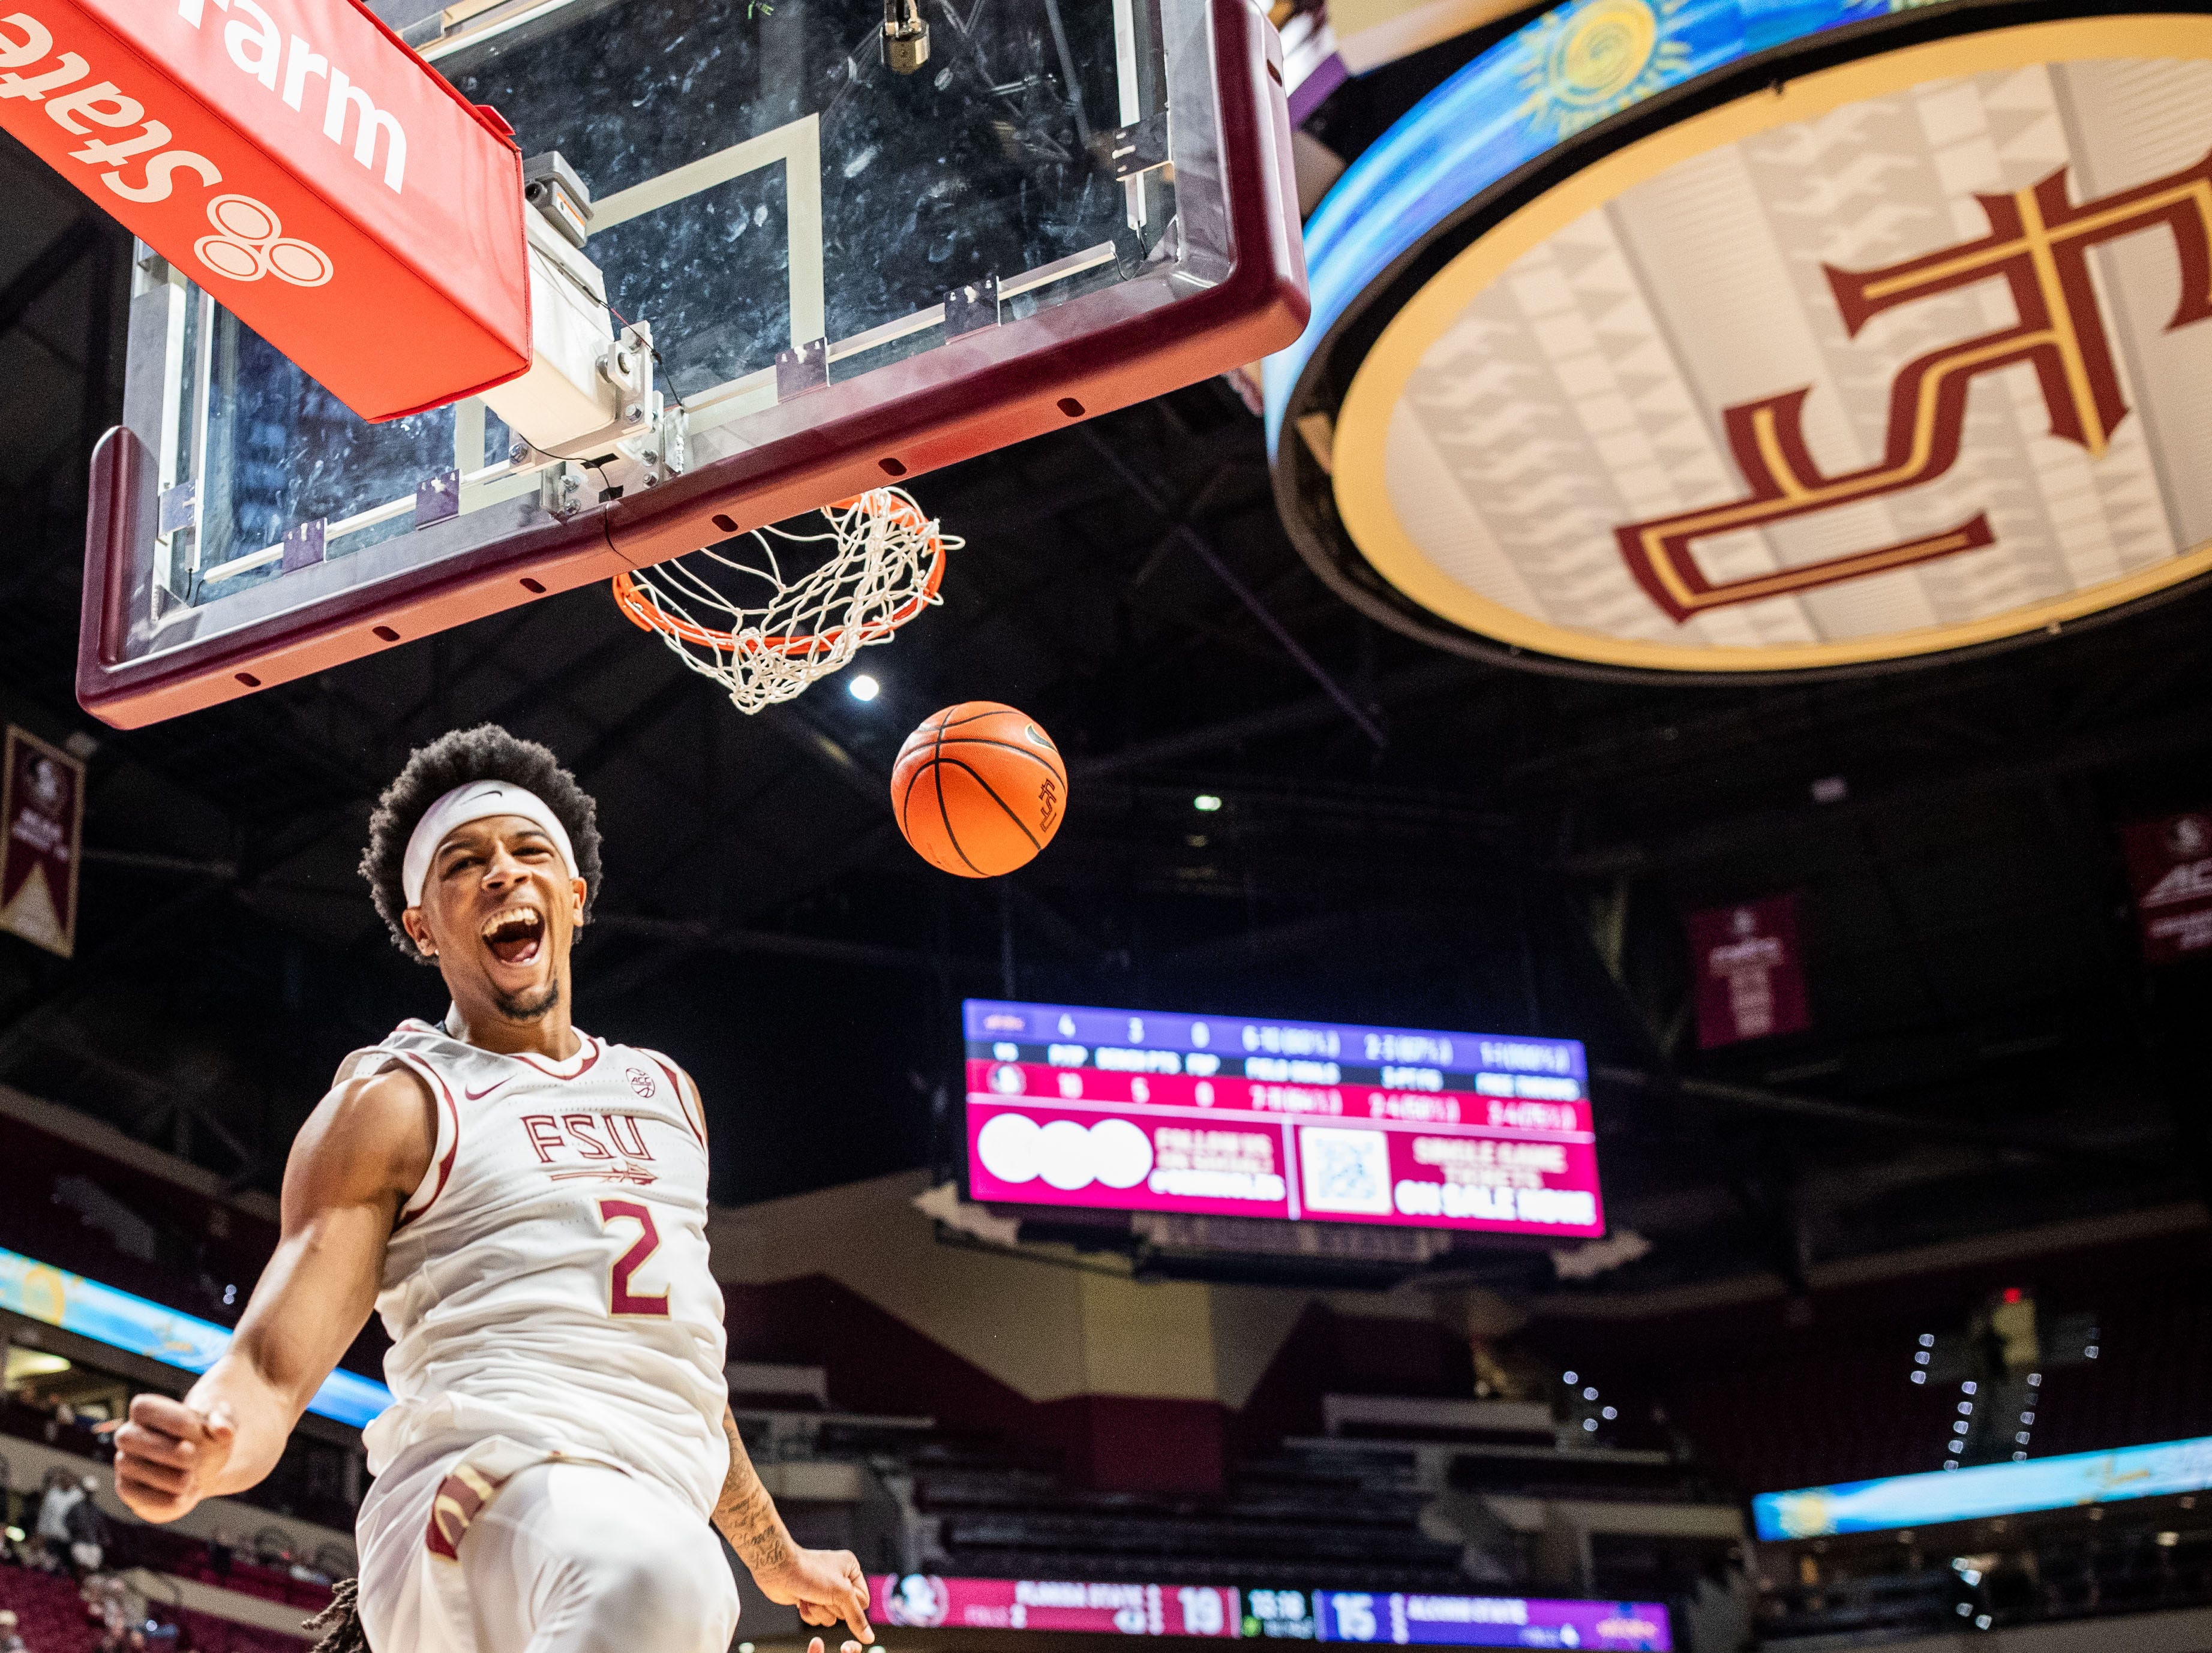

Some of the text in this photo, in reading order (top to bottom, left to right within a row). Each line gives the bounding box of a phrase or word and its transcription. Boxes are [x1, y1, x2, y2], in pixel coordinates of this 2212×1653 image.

[0, 13, 223, 203] State
[177, 0, 407, 194] arm
[1039, 778, 1057, 832] FSU
[521, 1114, 655, 1163] FSU
[596, 1198, 671, 1320] 2
